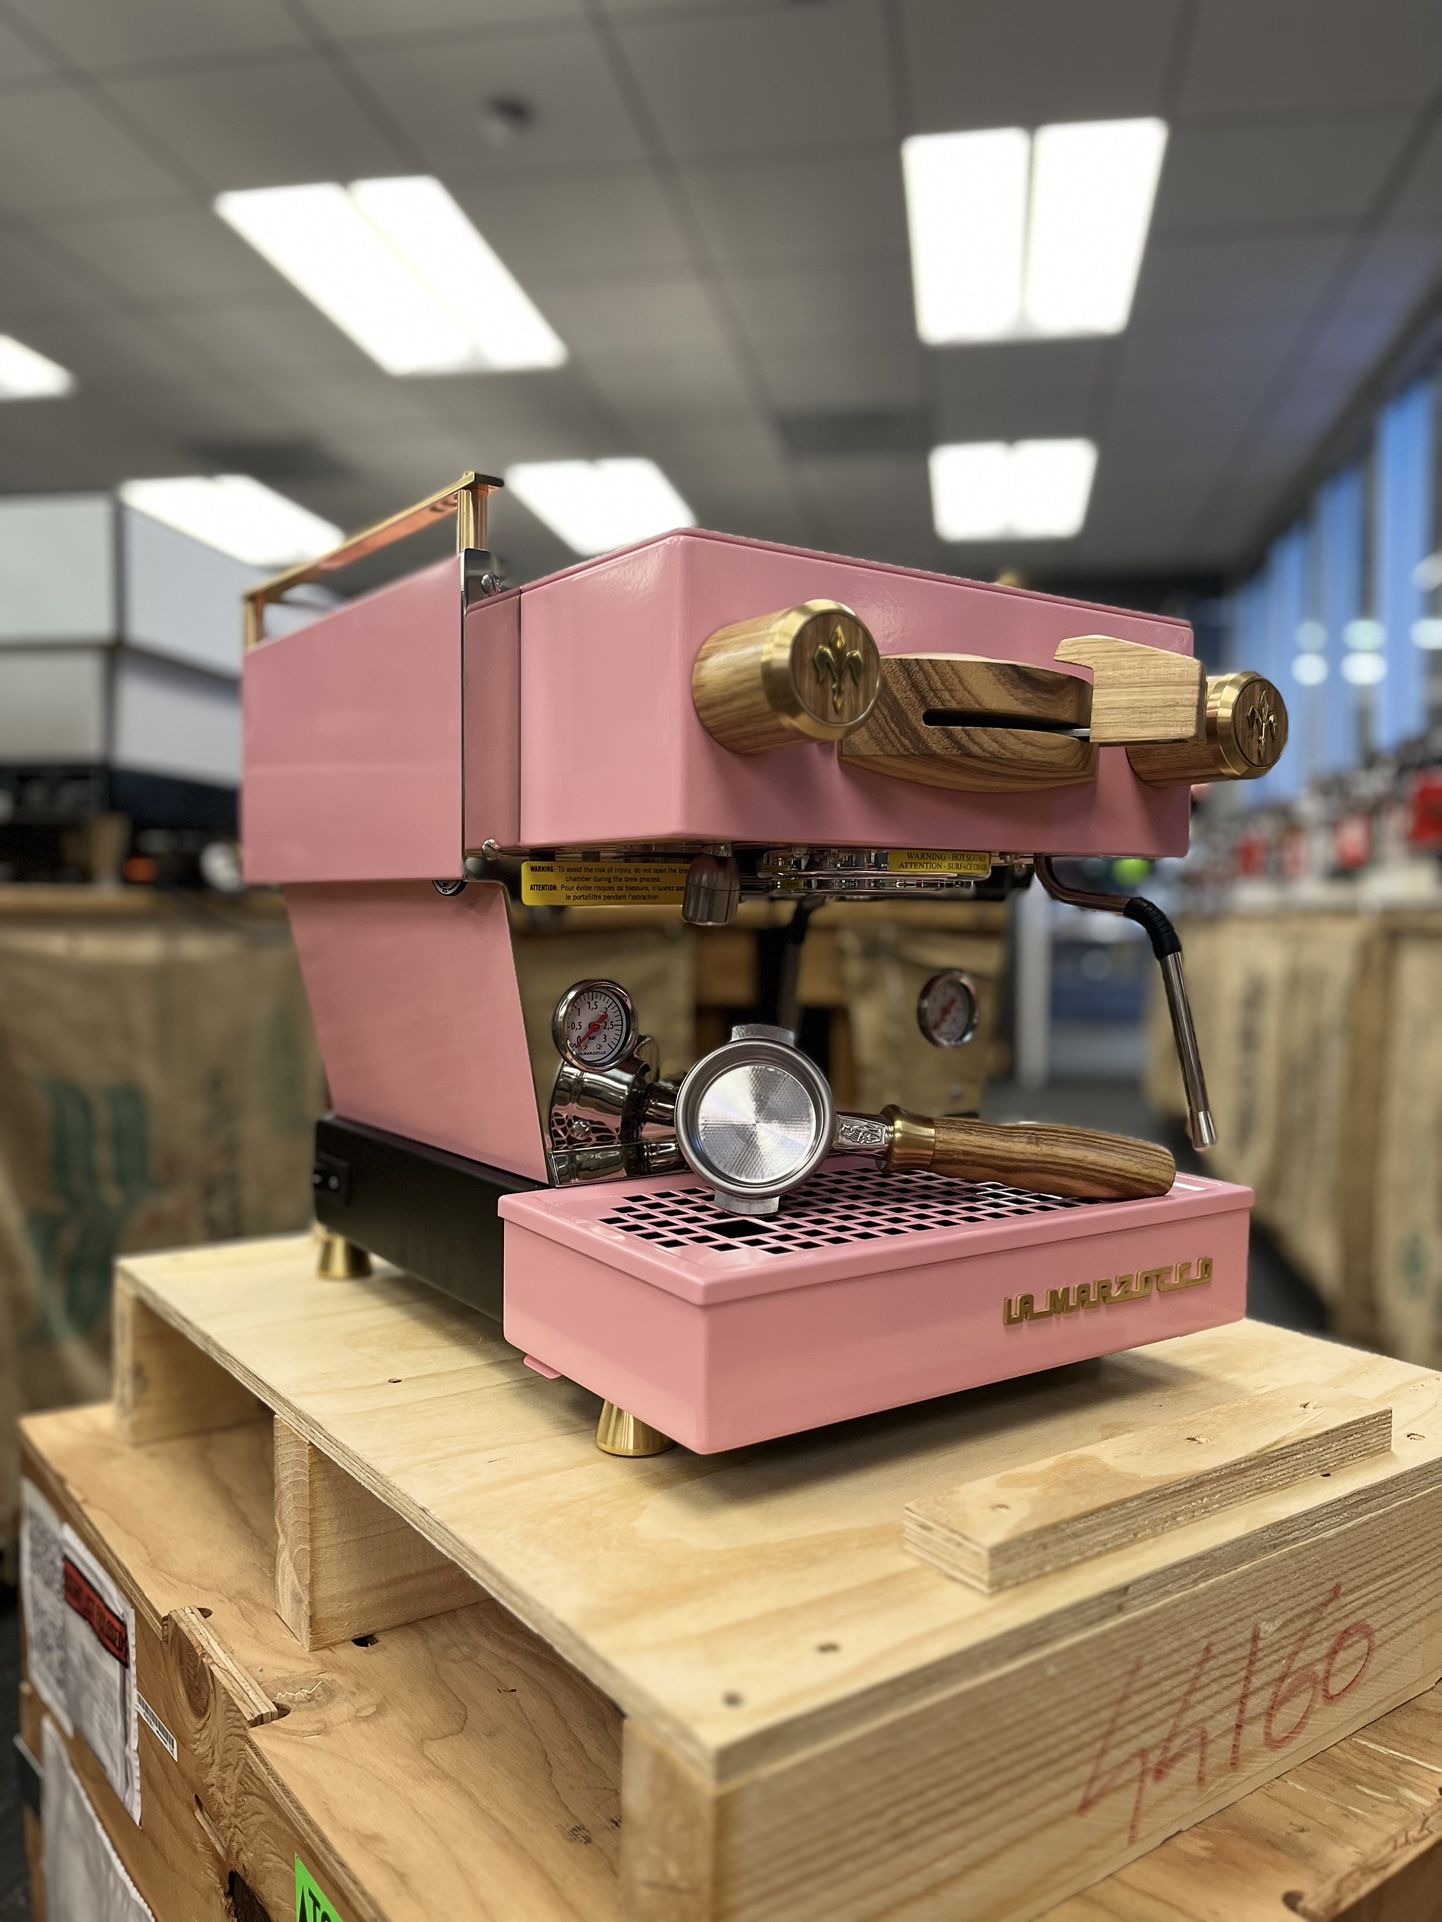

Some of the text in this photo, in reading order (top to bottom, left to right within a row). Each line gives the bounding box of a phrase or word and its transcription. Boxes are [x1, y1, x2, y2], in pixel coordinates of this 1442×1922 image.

[906, 852, 946, 861] WARNING
[898, 861, 942, 869] ATTENTION
[948, 862, 973, 870] SURFACE
[592, 875, 612, 884] during
[560, 884, 575, 892] Pour
[593, 885, 615, 893] risques
[572, 894, 602, 902] portafiltre
[603, 894, 627, 902] pendant
[587, 1001, 598, 1011] 1,5
[570, 1021, 582, 1032] 0,5
[603, 1021, 614, 1032] 2,5
[602, 1034, 607, 1043] 3
[1003, 1257, 1213, 1325] LA MARZOCCO
